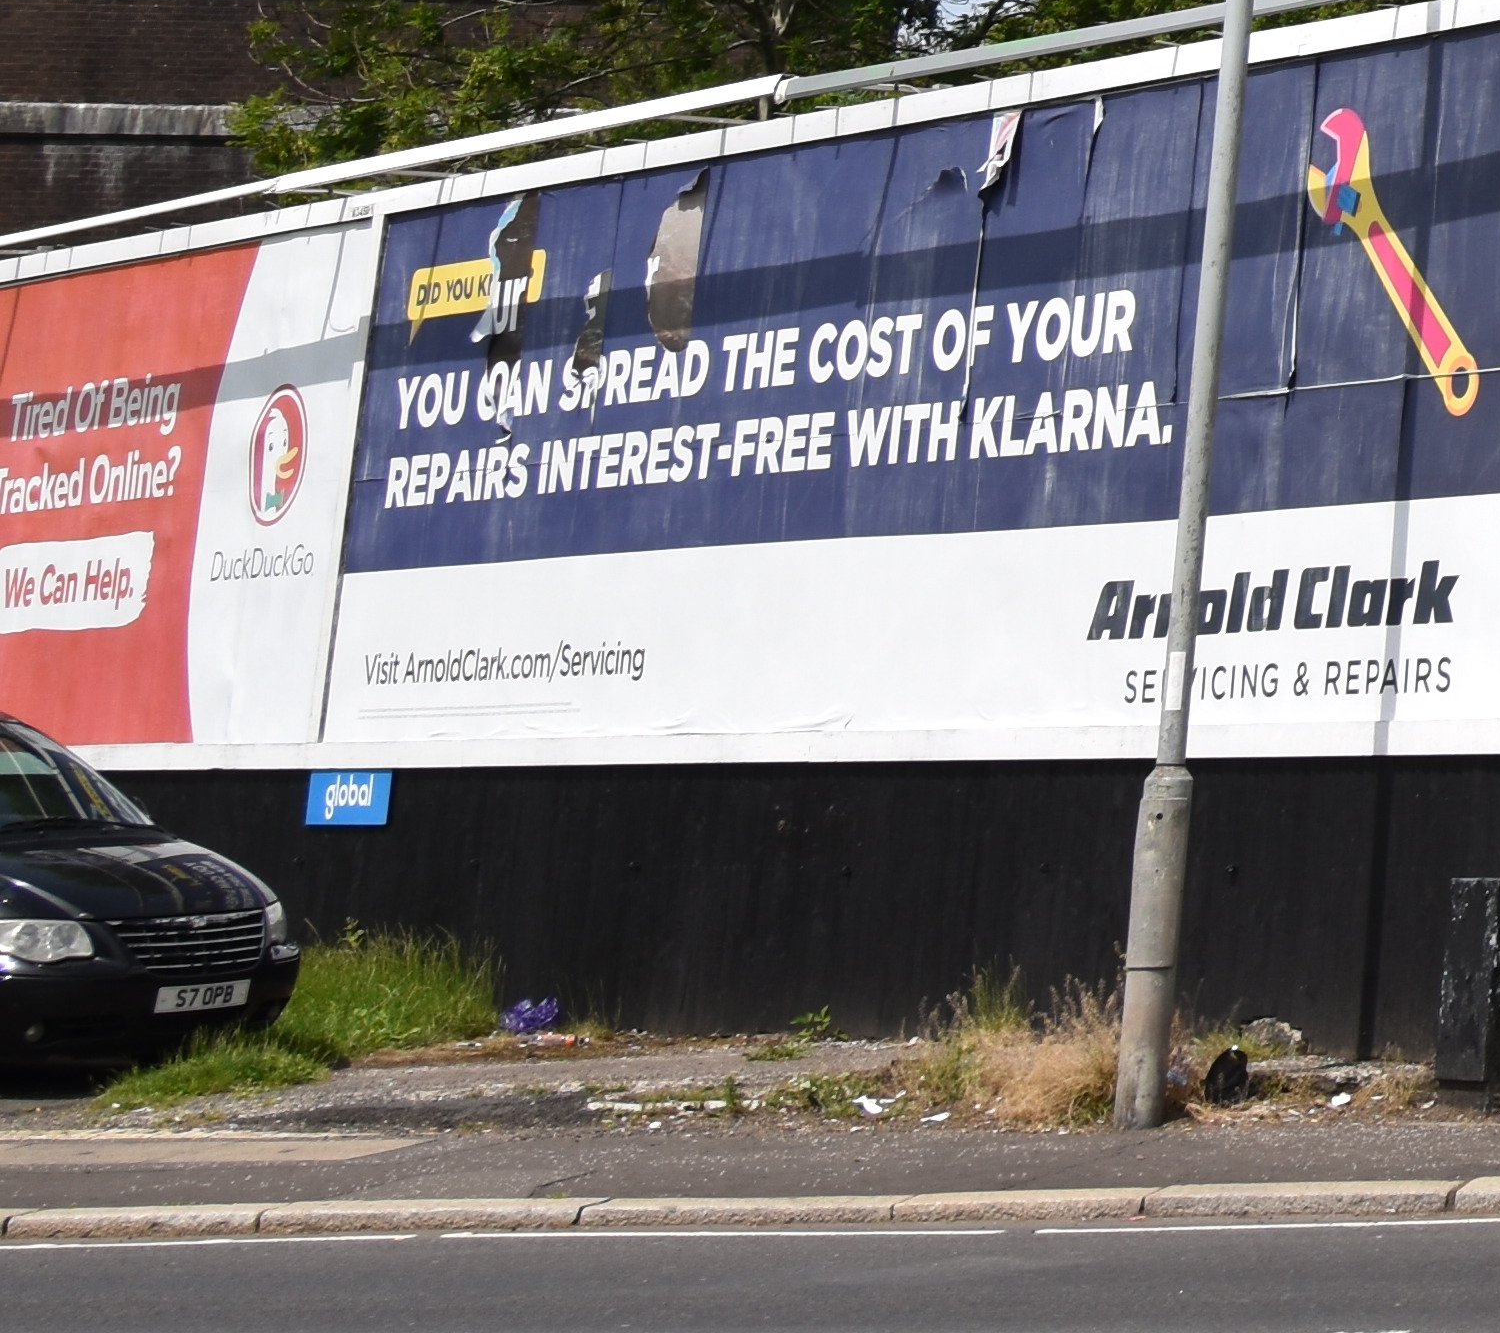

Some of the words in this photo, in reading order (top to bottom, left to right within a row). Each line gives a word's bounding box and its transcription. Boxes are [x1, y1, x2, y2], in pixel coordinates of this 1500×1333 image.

[416, 281, 440, 307] DID
[446, 276, 473, 302] YOU
[397, 369, 470, 431] YOU
[558, 339, 710, 412] SPREAD
[722, 326, 800, 393] THE
[808, 313, 923, 384] COST
[932, 304, 995, 373] OF
[1006, 288, 1137, 364] YOUR
[10, 386, 73, 443] Tired
[74, 379, 110, 434] Of
[107, 372, 183, 436] Being
[384, 441, 531, 510] REPAIRS
[536, 410, 836, 496] INTEREST-FREE
[848, 399, 962, 468] WITH
[969, 380, 1174, 460] KLARNA.
[89, 444, 182, 505] Online?
[4, 565, 36, 609] We
[39, 562, 79, 606] Can
[82, 556, 134, 611] Help.
[209, 543, 314, 582] DuckDuckGo
[1293, 559, 1460, 631] Clark
[365, 651, 400, 685] Visit
[402, 639, 646, 683] ArnoldClark.com/Servicing
[1293, 661, 1310, 697] &
[1324, 656, 1452, 696] REPAIRS
[324, 774, 375, 821] global
[175, 988, 200, 1008] S7
